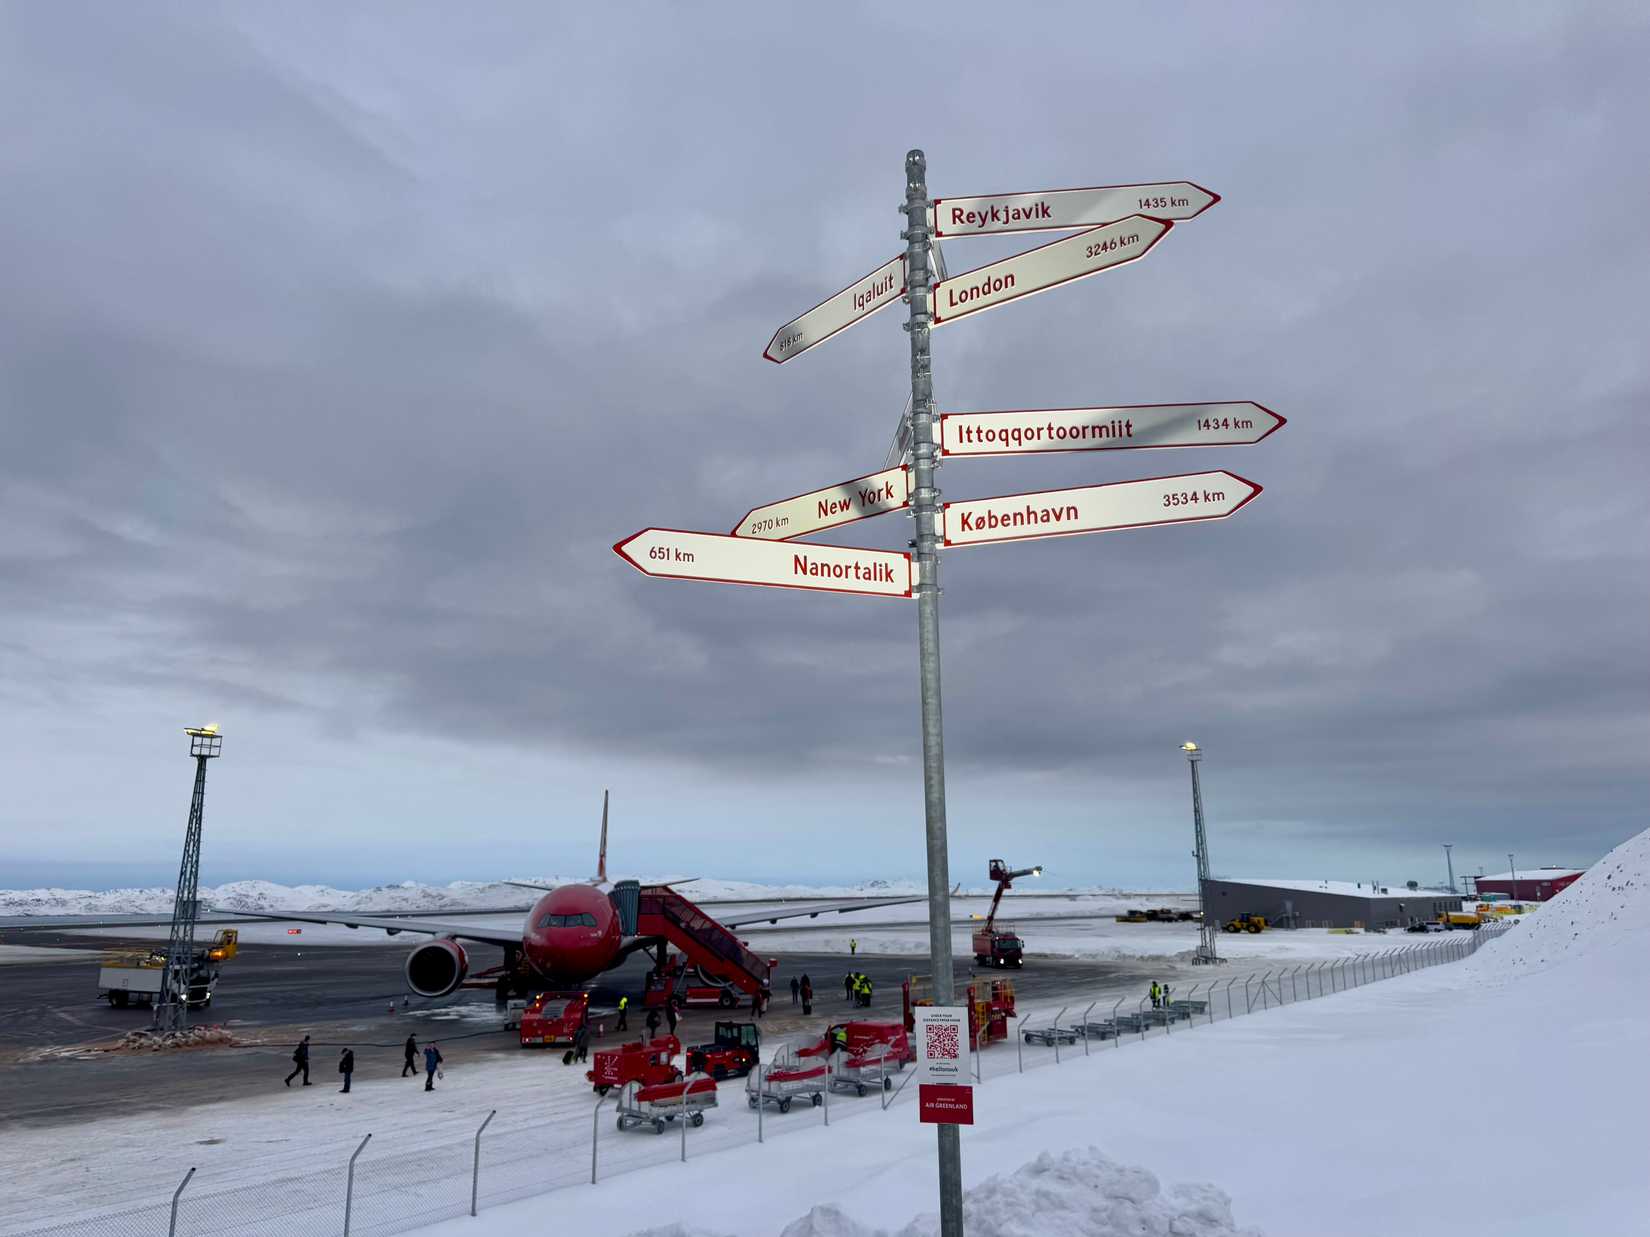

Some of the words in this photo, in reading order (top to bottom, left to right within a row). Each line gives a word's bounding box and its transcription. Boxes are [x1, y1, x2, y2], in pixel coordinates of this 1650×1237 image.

[952, 202, 1052, 228] Reykjavik
[1138, 197, 1167, 210] 1435
[1171, 196, 1189, 208] km
[949, 272, 1016, 308] London
[1086, 239, 1118, 259] 3246
[1119, 232, 1140, 249] km
[792, 331, 803, 345] km
[853, 272, 894, 312] Iqaluit
[957, 419, 1133, 446] Ittoqqortoormiit
[1197, 418, 1230, 431] 1434
[1233, 417, 1253, 430] km
[751, 518, 774, 535] 2970
[775, 515, 790, 529] km
[817, 495, 851, 519] New
[858, 481, 894, 507] York
[960, 504, 1079, 532] København
[1162, 493, 1199, 507] 3534
[1203, 490, 1225, 503] km
[649, 546, 671, 561] 651
[675, 548, 695, 563] km
[793, 554, 895, 583] Nanortalik
